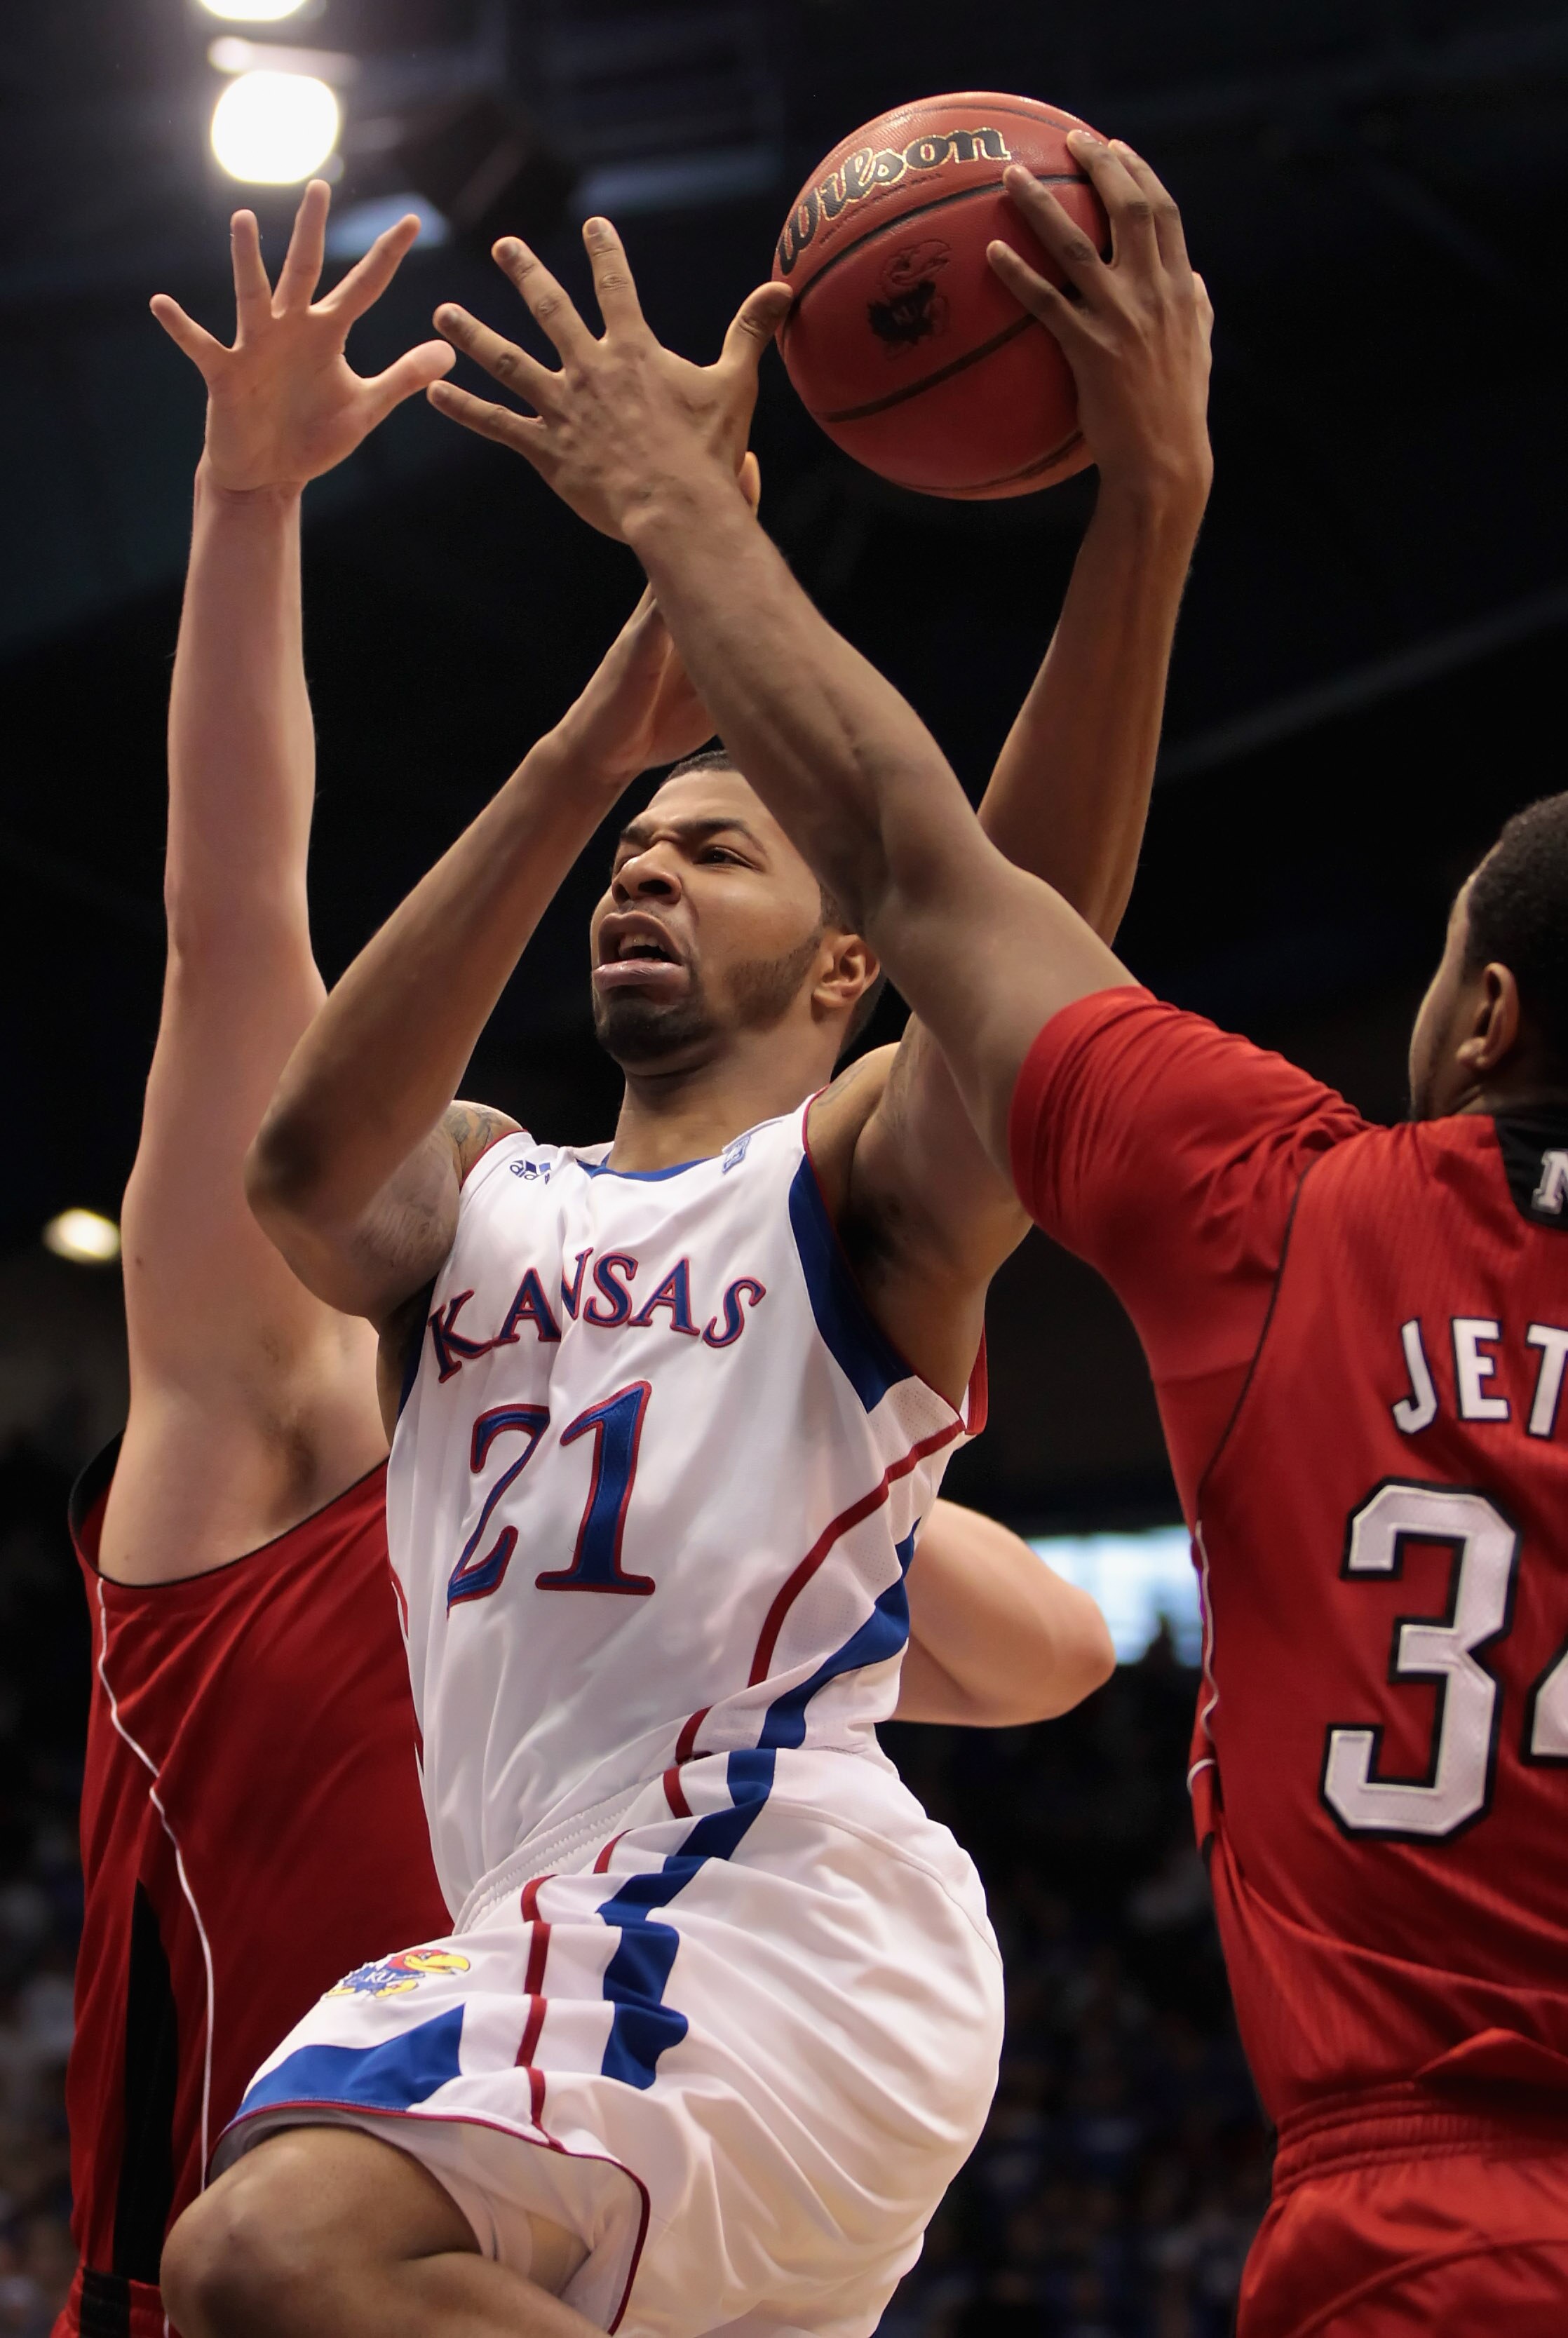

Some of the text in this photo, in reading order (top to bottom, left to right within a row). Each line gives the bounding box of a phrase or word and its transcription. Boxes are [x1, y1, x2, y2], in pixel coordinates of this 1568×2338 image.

[776, 126, 1012, 276] Wilson
[427, 1247, 766, 1383] KANSAS
[1391, 1317, 1568, 1439] JET
[446, 1379, 656, 1607] 21
[1320, 1476, 1568, 1842] 3
